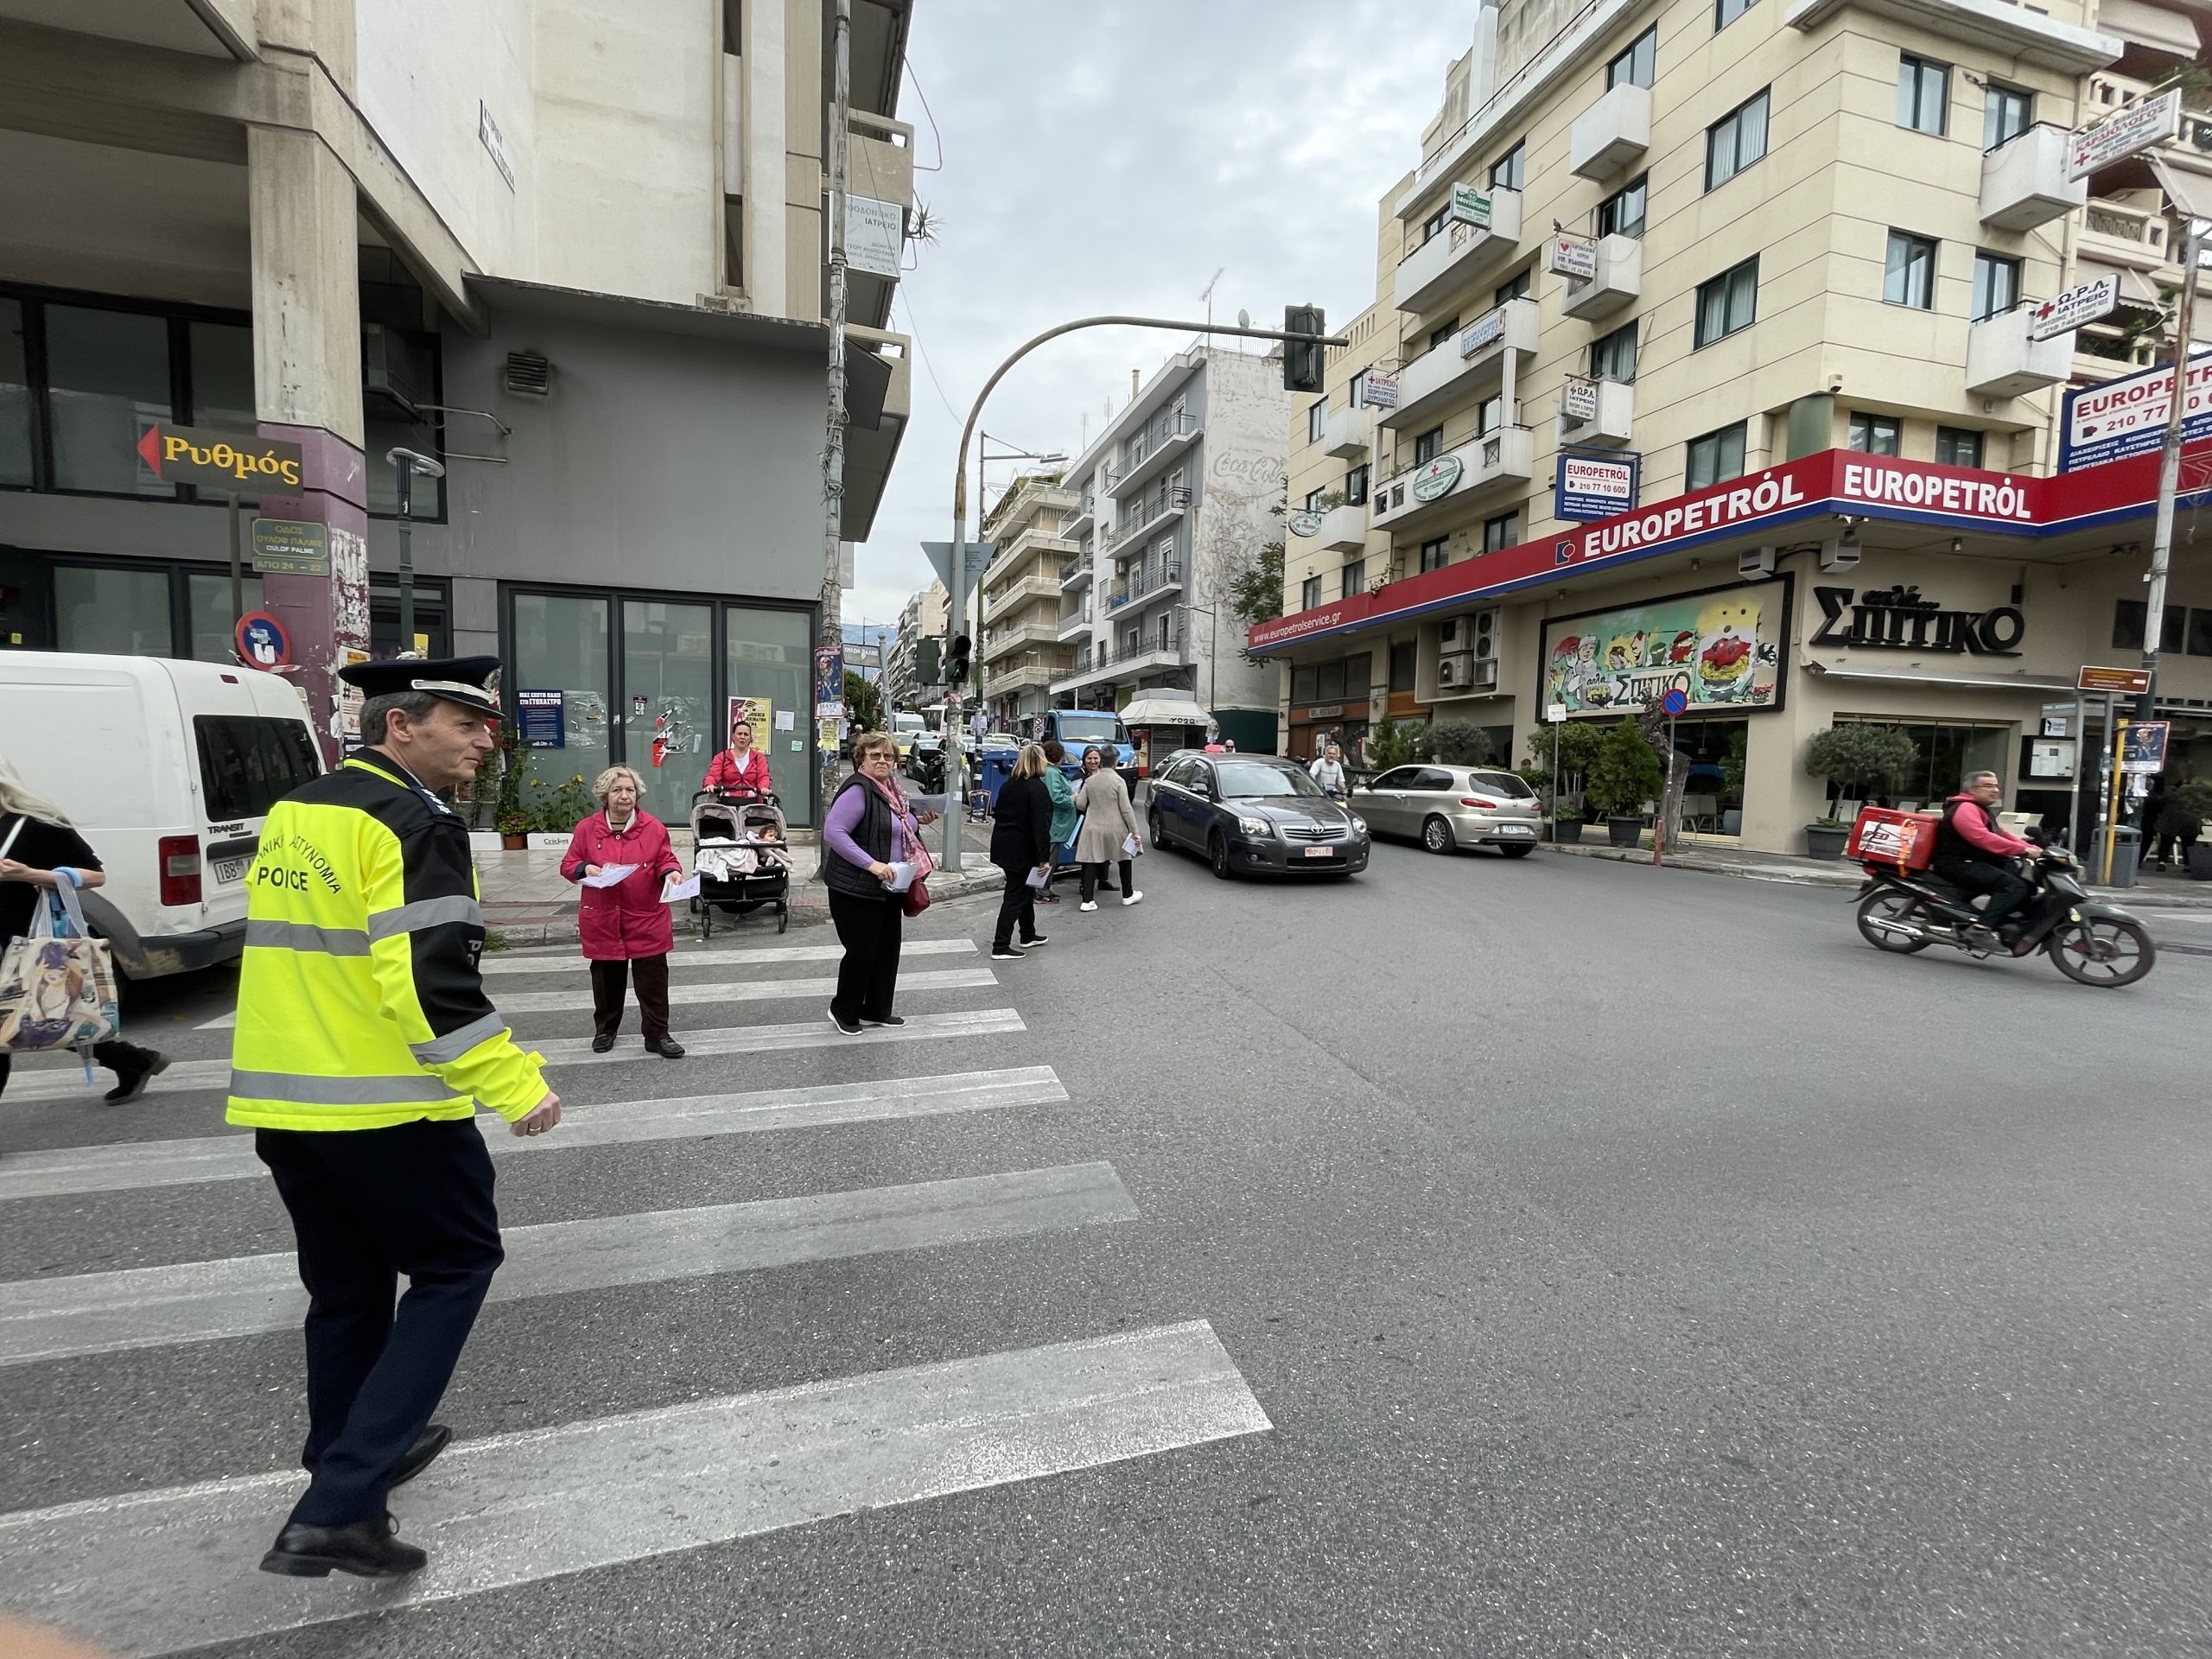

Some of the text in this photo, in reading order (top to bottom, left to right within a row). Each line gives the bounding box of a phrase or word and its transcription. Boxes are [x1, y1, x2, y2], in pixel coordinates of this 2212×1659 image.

[2075, 105, 2168, 153] ΚΑΡΔΙΟΛΟΓΟΣ
[865, 217, 896, 230] ΙΑΤΡΕΙΟ
[2058, 290, 2108, 314] ΙΑΤΡΕΙΟ
[2107, 416, 2135, 431] 210
[2143, 404, 2167, 421] 77
[163, 435, 299, 485] Ρυθμός
[276, 525, 304, 535] ΟΔΟΣ
[257, 535, 324, 547] ΟΥΛΟΦ ΠΑΛΜΕ
[291, 546, 315, 555] PALME
[1254, 612, 1342, 644] www.europetrolservice.gr
[207, 823, 245, 834] TRANSIT
